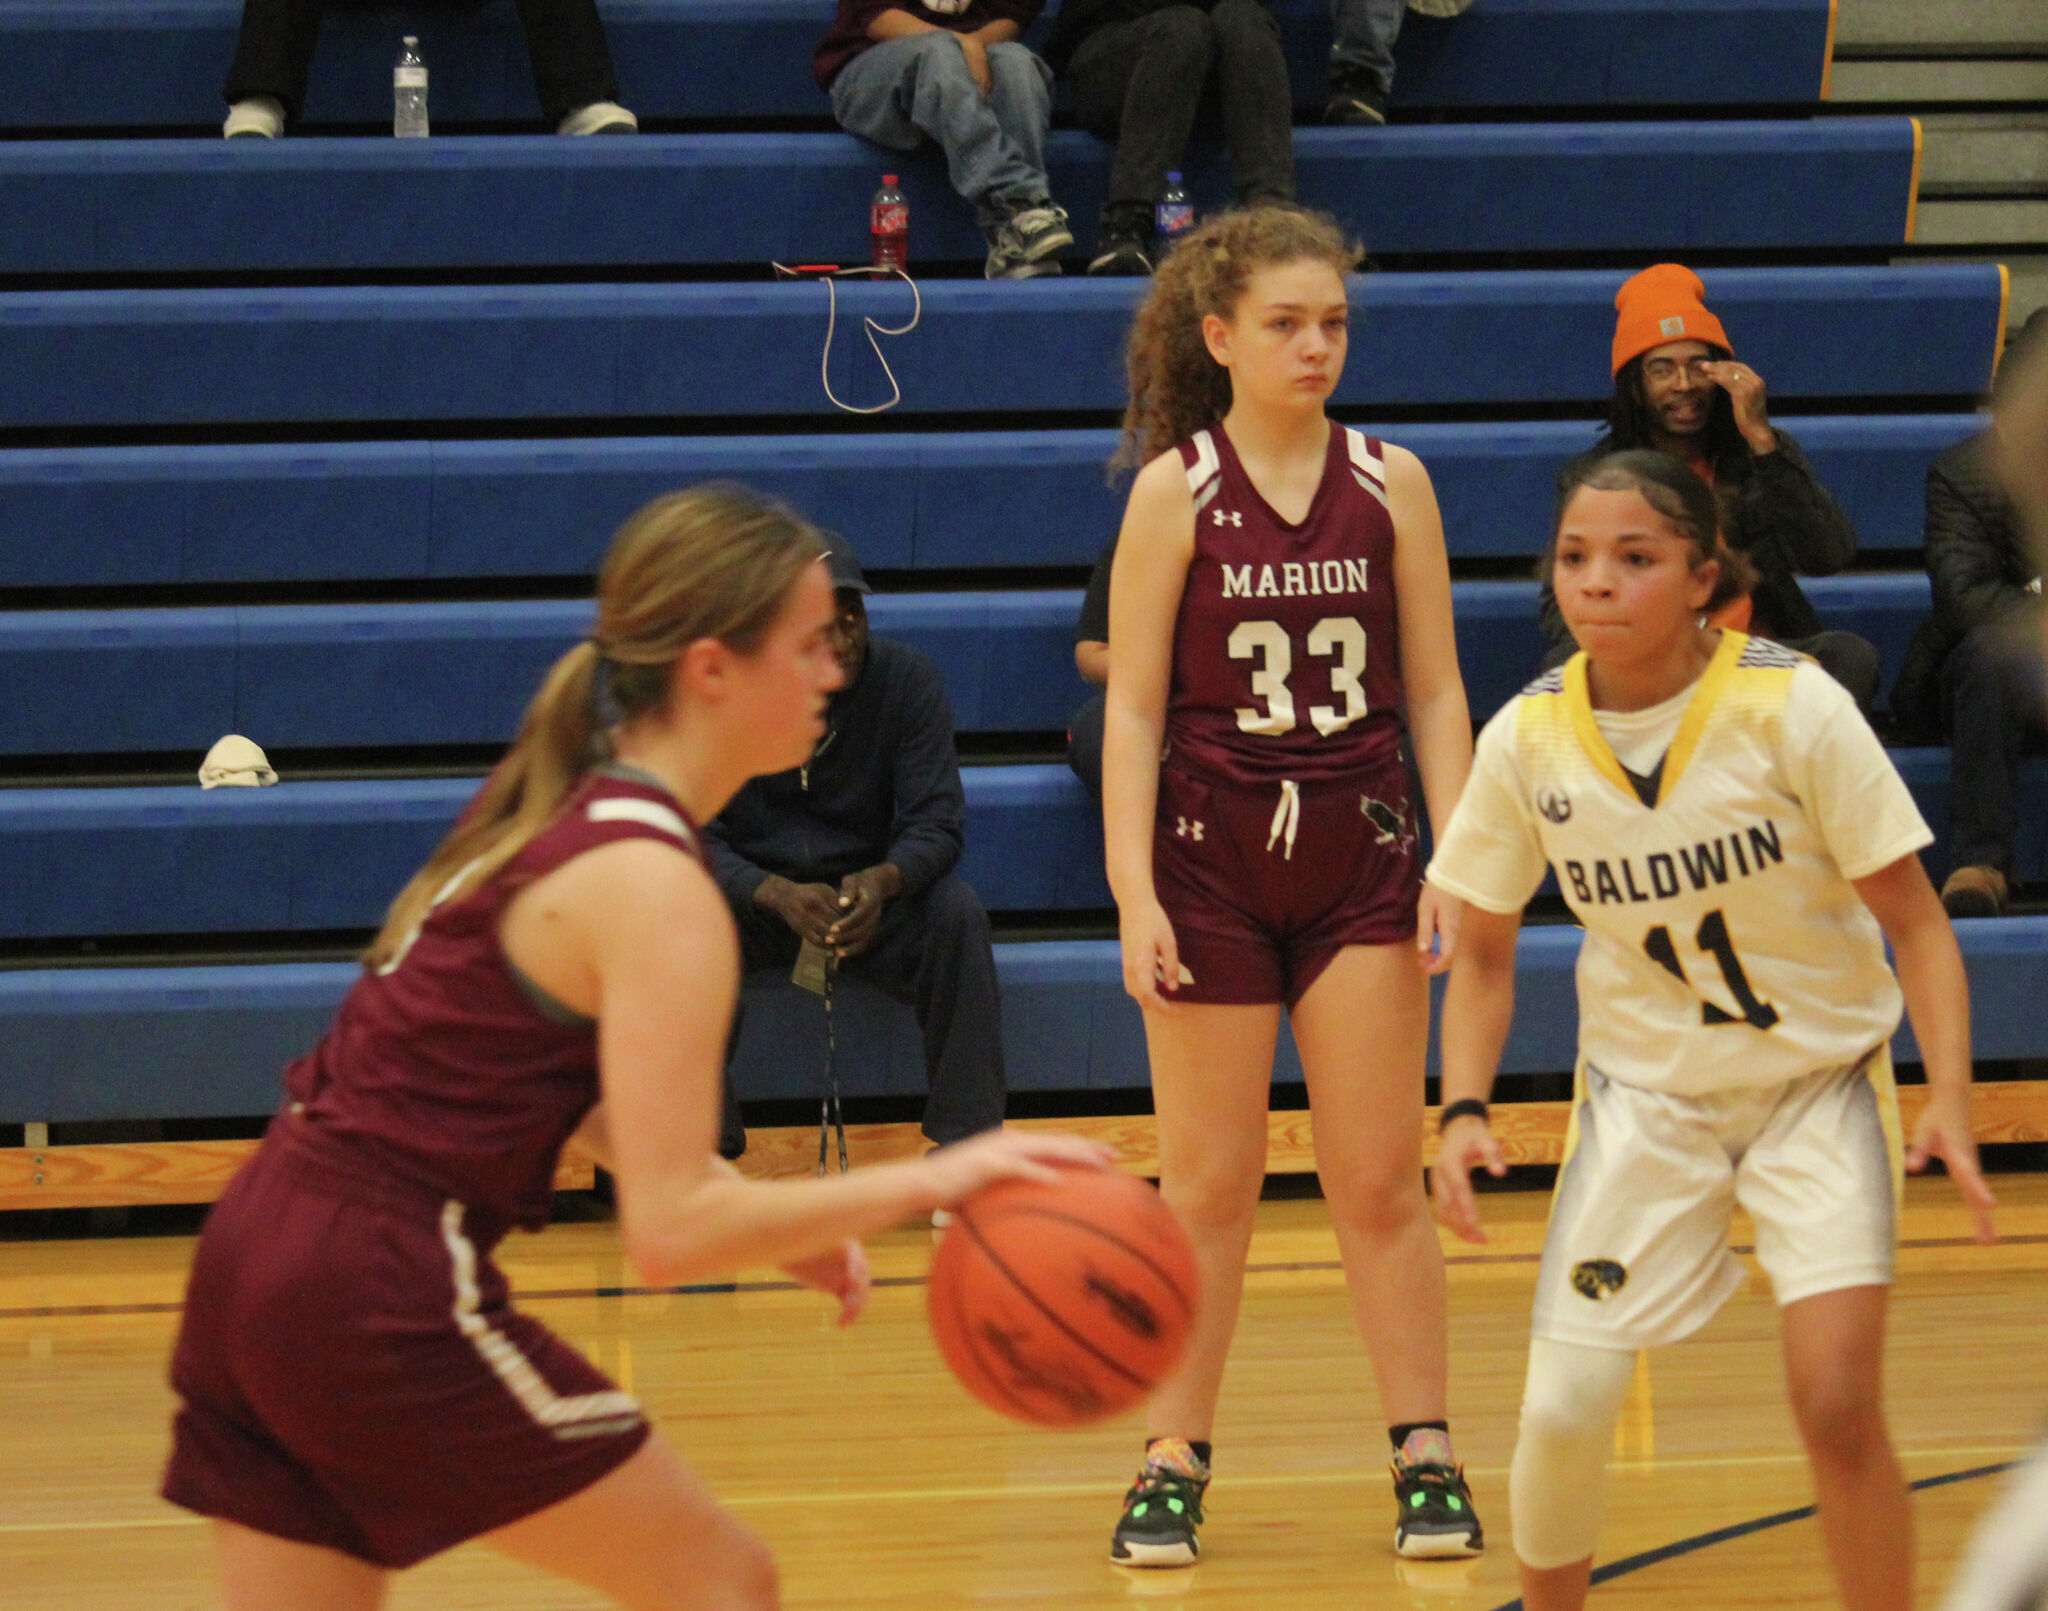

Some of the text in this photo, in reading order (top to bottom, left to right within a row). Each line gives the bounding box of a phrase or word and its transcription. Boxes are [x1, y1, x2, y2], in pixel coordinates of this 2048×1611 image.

[1222, 558, 1369, 598] MARION
[1227, 616, 1368, 737] 33
[1566, 819, 1783, 904] BALDWIN
[1643, 908, 1779, 1030] 11
